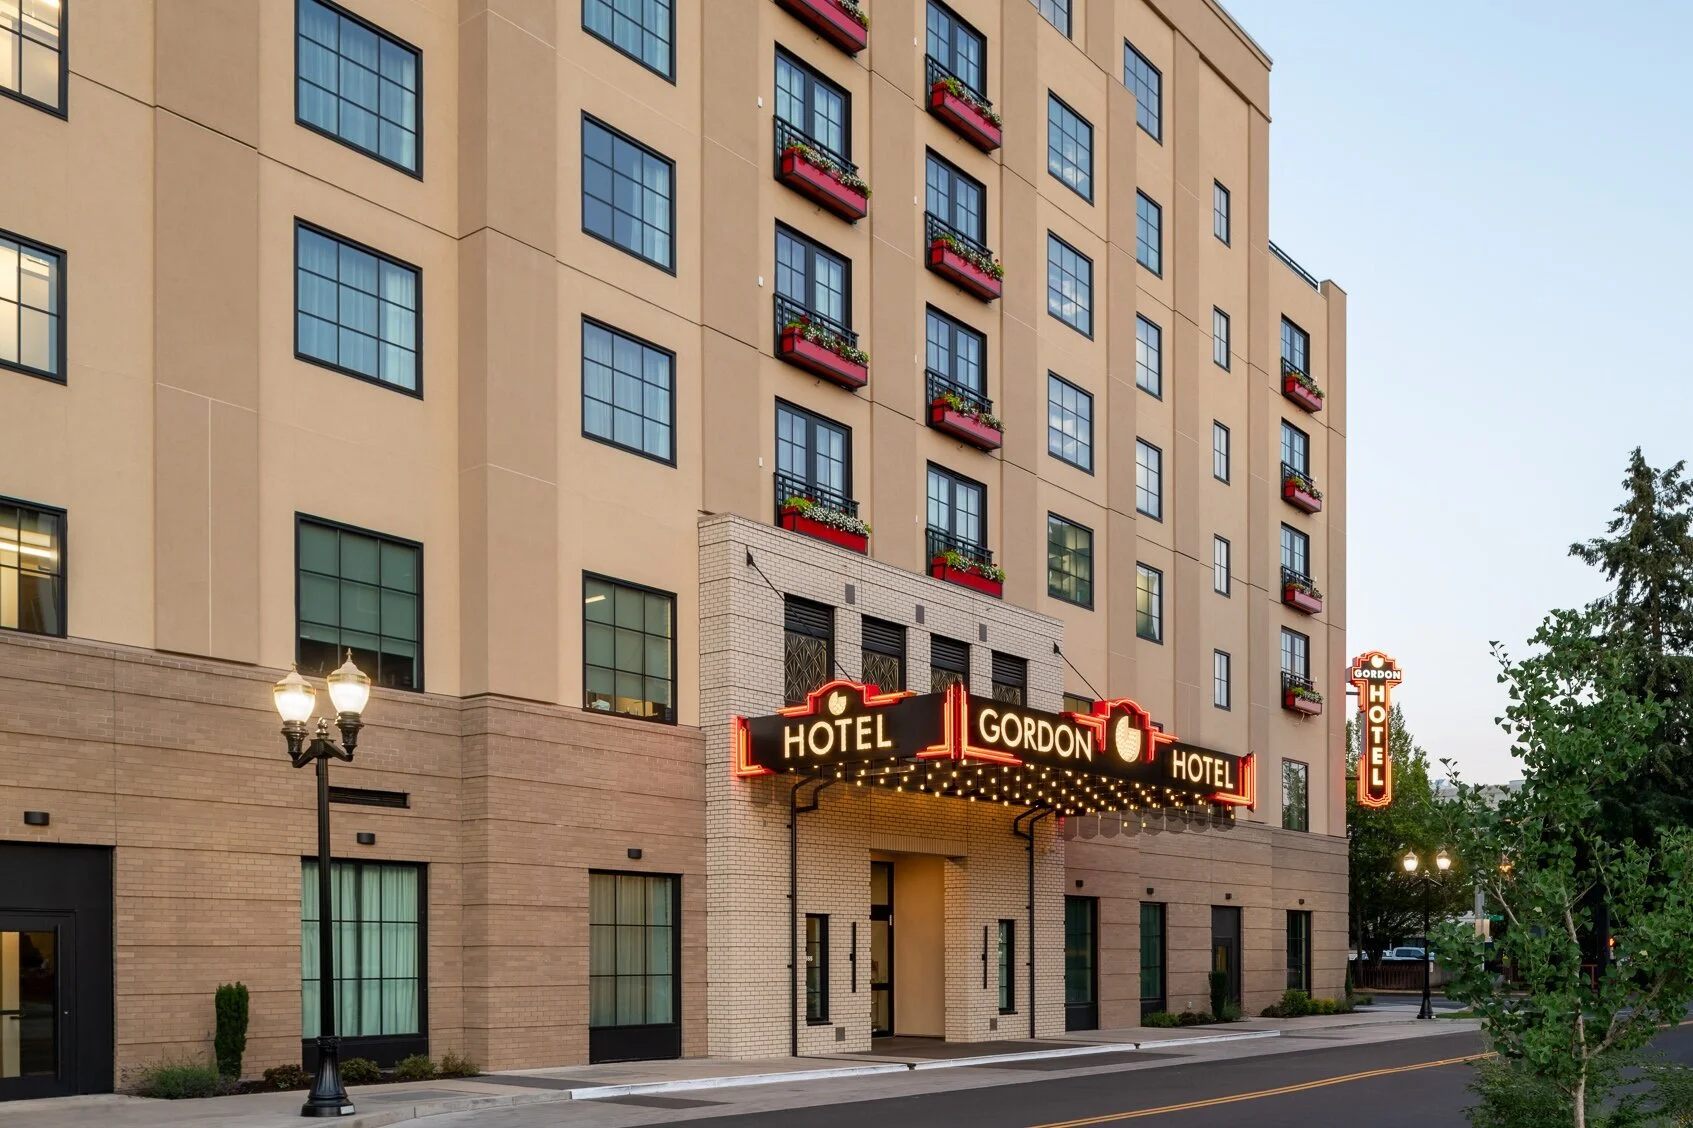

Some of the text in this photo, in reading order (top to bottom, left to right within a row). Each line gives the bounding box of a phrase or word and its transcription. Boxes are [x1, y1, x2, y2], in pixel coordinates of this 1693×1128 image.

[1354, 669, 1401, 680] GORDON
[784, 714, 892, 758] HOTEL
[979, 708, 1234, 789] GORDON HOTEL
[1368, 684, 1386, 786] HOTEL
